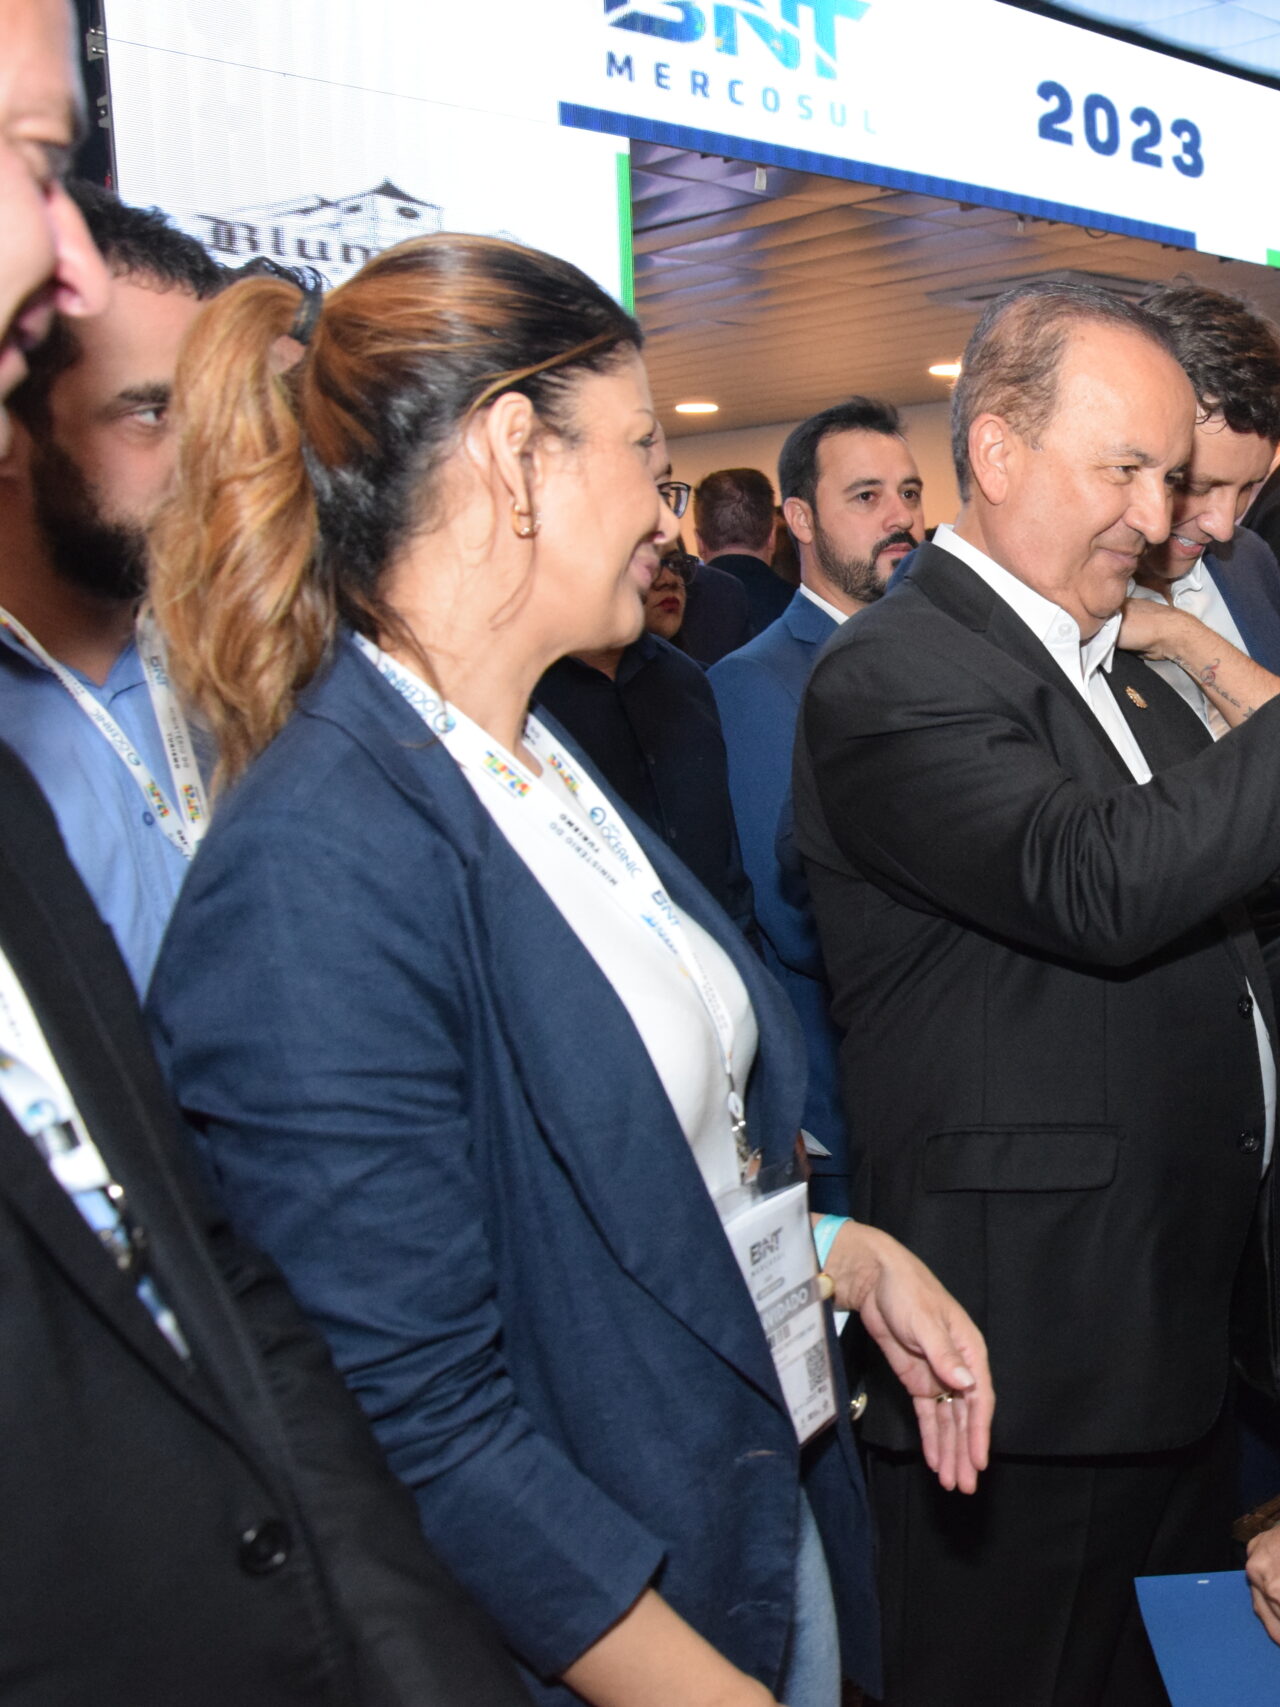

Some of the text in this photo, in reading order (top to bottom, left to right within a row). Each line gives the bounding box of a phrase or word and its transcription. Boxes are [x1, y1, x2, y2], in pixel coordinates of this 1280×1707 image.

[606, 50, 877, 135] MERCOSUL
[1037, 79, 1204, 178] 2023
[559, 812, 599, 853] TURISMO
[750, 1226, 783, 1267] BNT
